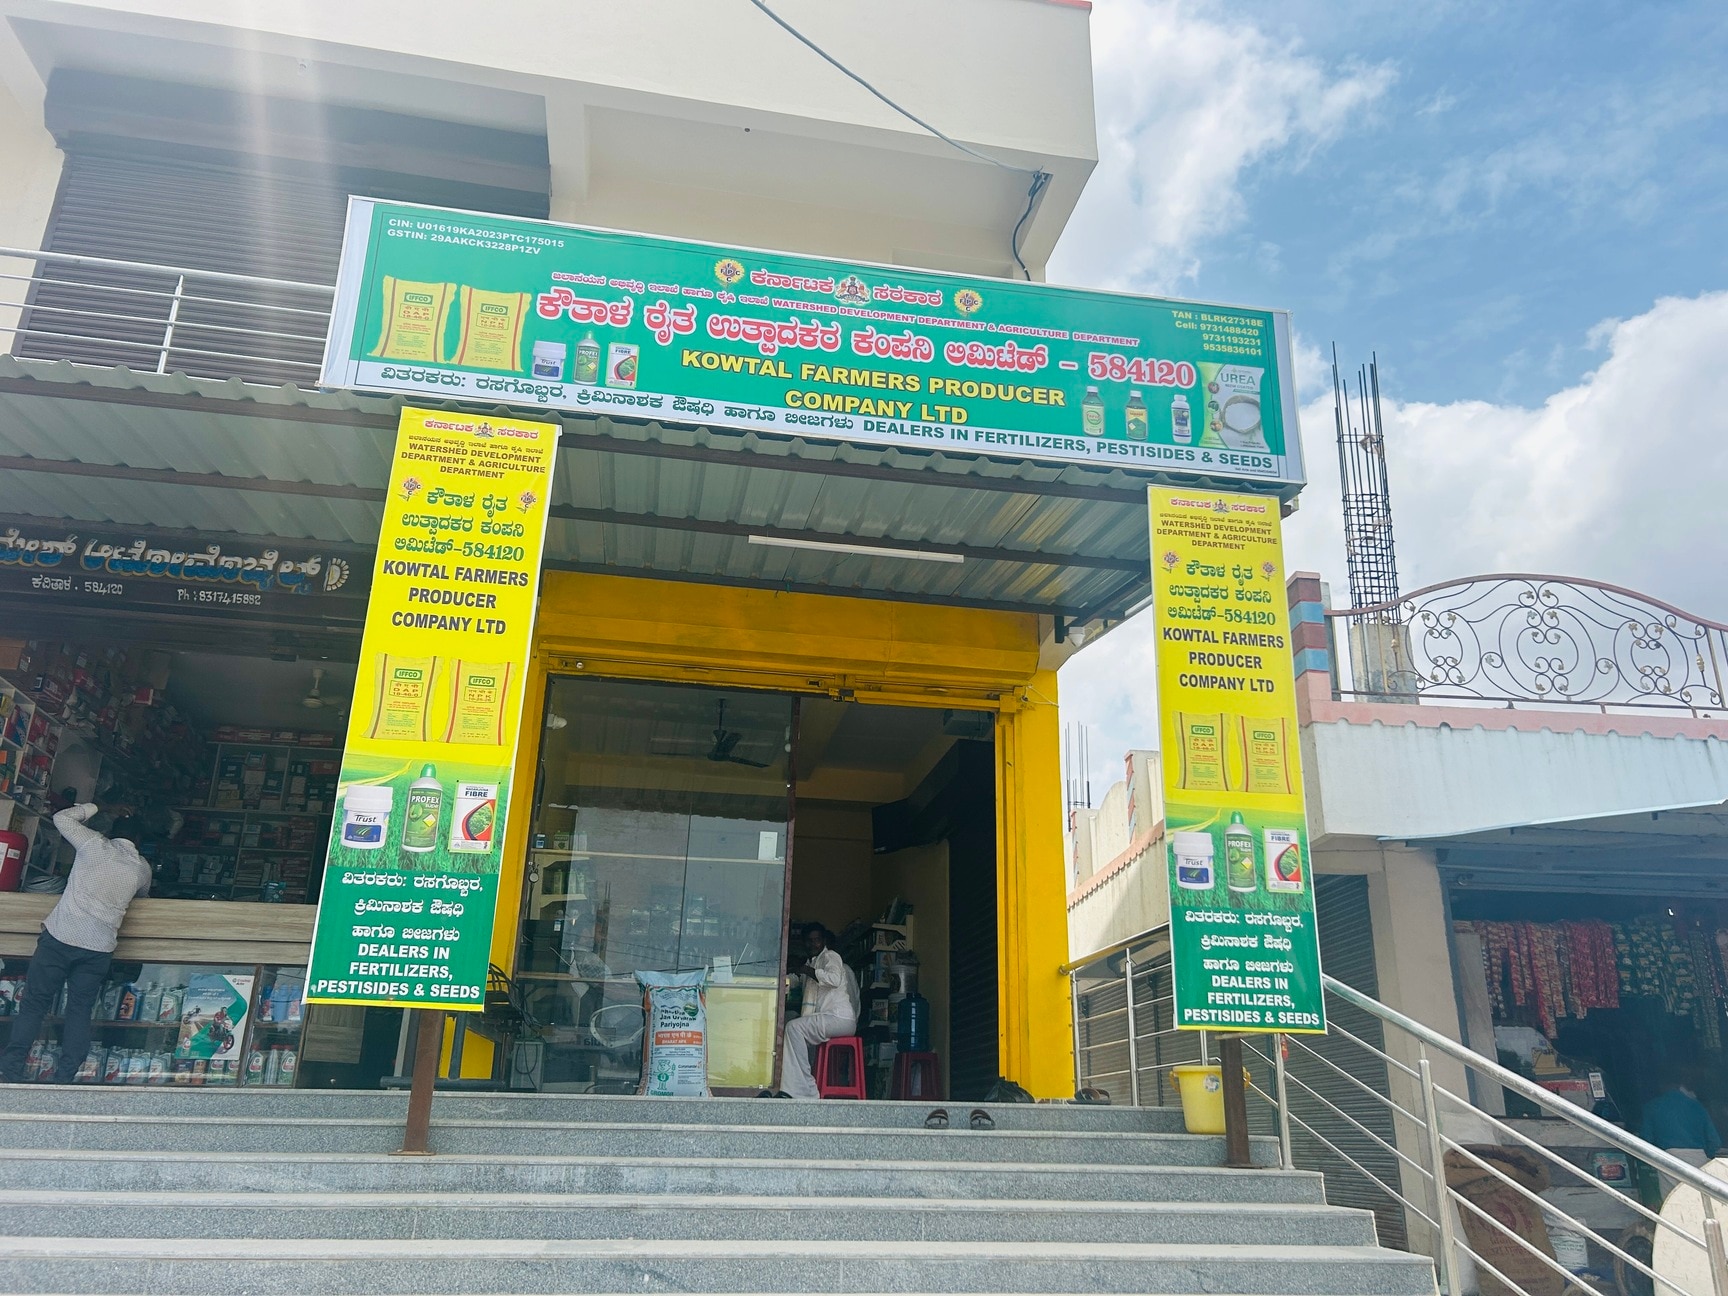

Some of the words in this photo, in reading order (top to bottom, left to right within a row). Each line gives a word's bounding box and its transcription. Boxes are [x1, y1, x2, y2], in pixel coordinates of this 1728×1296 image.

[387, 228, 427, 240] GSTIN:
[430, 233, 541, 255] 29AAKCK3228P1ZV
[388, 218, 413, 228] CIN:
[416, 221, 565, 248] U01619KA2023PTC175015
[751, 268, 833, 293] ಕರ್ನಾಟಕ
[873, 284, 942, 307] ಸರಕಾರ
[408, 295, 429, 303] IFFCO
[484, 305, 505, 313] IFFCO
[553, 271, 605, 285] ಜಲಾನಯನ
[649, 283, 678, 294] ಇಲಾಖೆ
[683, 288, 712, 298] ಹಾಗೂ
[718, 292, 735, 304] ಕೃಷಿ
[740, 295, 768, 305] ಇಲಾಖೆ
[773, 299, 837, 314] WATERSHED
[840, 308, 915, 323] DEVELOPMENT
[918, 316, 985, 330] DEPARTMENT
[988, 324, 996, 332] &
[999, 325, 1068, 339] AGRICULTURE
[1073, 332, 1139, 346] DEPARTMENT
[1172, 311, 1192, 320] TAN
[1201, 314, 1264, 327] BLRK27318E
[1175, 321, 1198, 330] Cell:
[1200, 324, 1259, 336] 9731488420
[539, 288, 632, 326] ಕೌತಾಳ
[645, 302, 696, 344] ರೈತ
[709, 314, 840, 353] ಉತ್ಪಾದಕರ
[854, 326, 932, 361] ಕಂಪನಿ
[946, 341, 1046, 372] ಲಿಮಿಟೆಡ್
[1089, 354, 1194, 388] 584120
[682, 349, 793, 379] KOWTAL
[801, 363, 921, 393] FARMERS
[929, 377, 1066, 407] PRODUCER
[1220, 373, 1256, 386] UREA
[785, 390, 913, 419] COMPANY
[920, 403, 968, 425] LTD
[381, 366, 466, 387] ವಿತರಕರು:
[476, 376, 567, 403] ರಸಗೊಬ್ಬರ,
[577, 388, 664, 408] ಕ್ರಿಮಿನಾಶಕ
[672, 396, 715, 417] ಔಷಧಿ
[724, 405, 776, 422] ಹಾಗೂ
[785, 412, 853, 430] ಬೀಜಗಳು
[863, 420, 944, 439] DEALERS
[950, 428, 969, 441] IN
[974, 430, 1091, 455] FERTILIZERS,
[1096, 441, 1195, 462] PESTISIDES
[1201, 452, 1213, 463] &
[1219, 453, 1273, 469] SEEDS
[424, 419, 474, 433] ಕರ್ನಾಟಕ
[497, 427, 539, 440] ಸರಕಾರ
[409, 442, 468, 456] WATERSHED
[470, 449, 541, 464] DEVELOPMENT
[401, 452, 466, 465] DEPARTMENT
[478, 460, 546, 474] AGRICULTURE
[440, 466, 505, 479] DEPARTMENT
[427, 487, 475, 509] ಕೌತಾಳ
[482, 494, 508, 517] ರೈತ
[1170, 498, 1211, 508] ಕರ್ನಾಟಕ
[401, 512, 473, 535] ಉತ್ಪಾದಕರ
[481, 519, 525, 538] ಕಂಪನಿ
[1161, 519, 1211, 530] WATERSHED
[1213, 524, 1272, 535] DEVELOPMENT
[1156, 528, 1211, 539] DEPARTMENT
[1221, 534, 1278, 545] AGRICULTURE
[1191, 540, 1246, 550] DEPARTMENT
[383, 559, 450, 580] KOWTAL
[454, 566, 529, 587] FARMERS
[1186, 560, 1226, 578] ಕೌತಾಳ
[1232, 564, 1253, 586] ರೈತ
[84, 581, 123, 595] 584120
[177, 588, 190, 600] Ph
[1168, 584, 1229, 603] ಉತ್ಪಾದಕರ
[1235, 588, 1272, 603] ಕಂಪನಿ
[408, 587, 497, 609] PRODUCER
[392, 612, 472, 632] COMPANY
[476, 618, 506, 635] LTD
[1163, 627, 1219, 643] KOWTAL
[1223, 631, 1284, 649] FARMERS
[1189, 651, 1263, 669] PRODUCER
[398, 670, 418, 678] IFFCO
[1179, 673, 1245, 691] COMPANY
[1250, 679, 1274, 693] LTD
[411, 795, 440, 804] PROFEX
[354, 814, 377, 823] Trust
[1227, 840, 1251, 848] PROFEX
[1185, 858, 1203, 866] Trust
[342, 871, 407, 887] ವಿತರಕರು:
[414, 875, 484, 897] ರಸಗೊಬ್ಬರ,
[354, 898, 424, 916] ಕ್ರಿಮಿನಾಶಕ
[430, 899, 464, 918] ಔಷಧಿ
[1185, 910, 1240, 924] ವಿತರಕರು:
[1244, 912, 1304, 933] ರಸಗೊಬ್ಬರ,
[352, 923, 395, 939] ಹಾಗೂ
[402, 926, 460, 941] ಬೀಜಗಳು
[1201, 933, 1258, 950] ಕ್ರಿಮಿನಾಶಕ
[358, 943, 429, 959] DEALERS
[433, 946, 450, 960] IN
[349, 962, 453, 981] FERTILIZERS,
[1203, 957, 1240, 971] ಹಾಗೂ
[1245, 959, 1294, 973] ಬೀಜಗಳು
[317, 979, 409, 996] PESTISIDES
[413, 983, 425, 996] &
[430, 984, 480, 999] SEEDS
[1211, 975, 1271, 989] DEALERS
[1274, 978, 1289, 990] IN
[1207, 992, 1295, 1009] FERTILIZERS,
[1184, 1008, 1261, 1023] PESTISIDES
[1264, 1012, 1275, 1023] &
[1278, 1012, 1320, 1025] SEEDS
